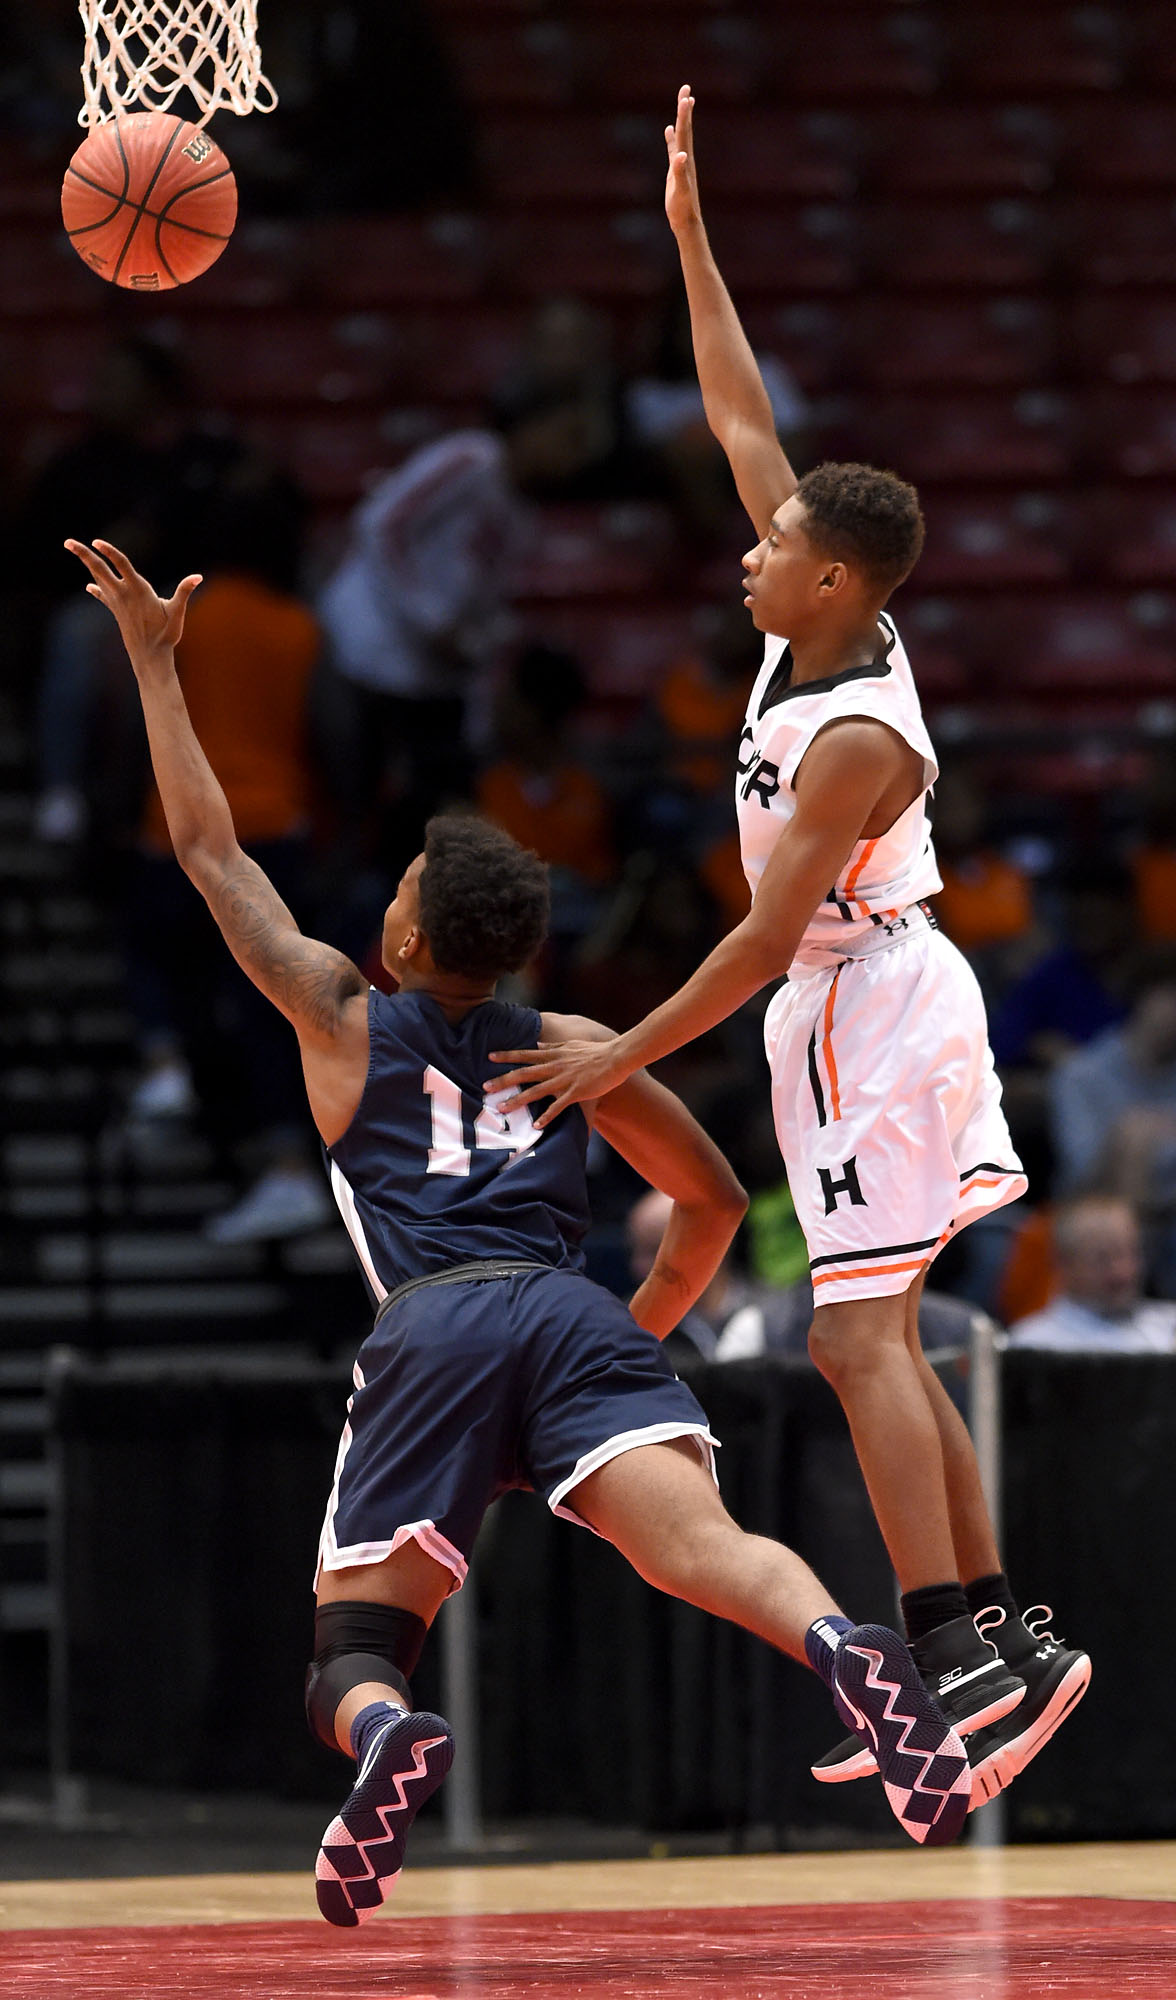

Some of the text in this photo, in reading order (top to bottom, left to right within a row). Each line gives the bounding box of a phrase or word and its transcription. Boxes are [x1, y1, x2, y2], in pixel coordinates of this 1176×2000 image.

[423, 1064, 544, 1177] 14
[816, 1154, 868, 1217] H
[939, 1666, 962, 1687] SC
